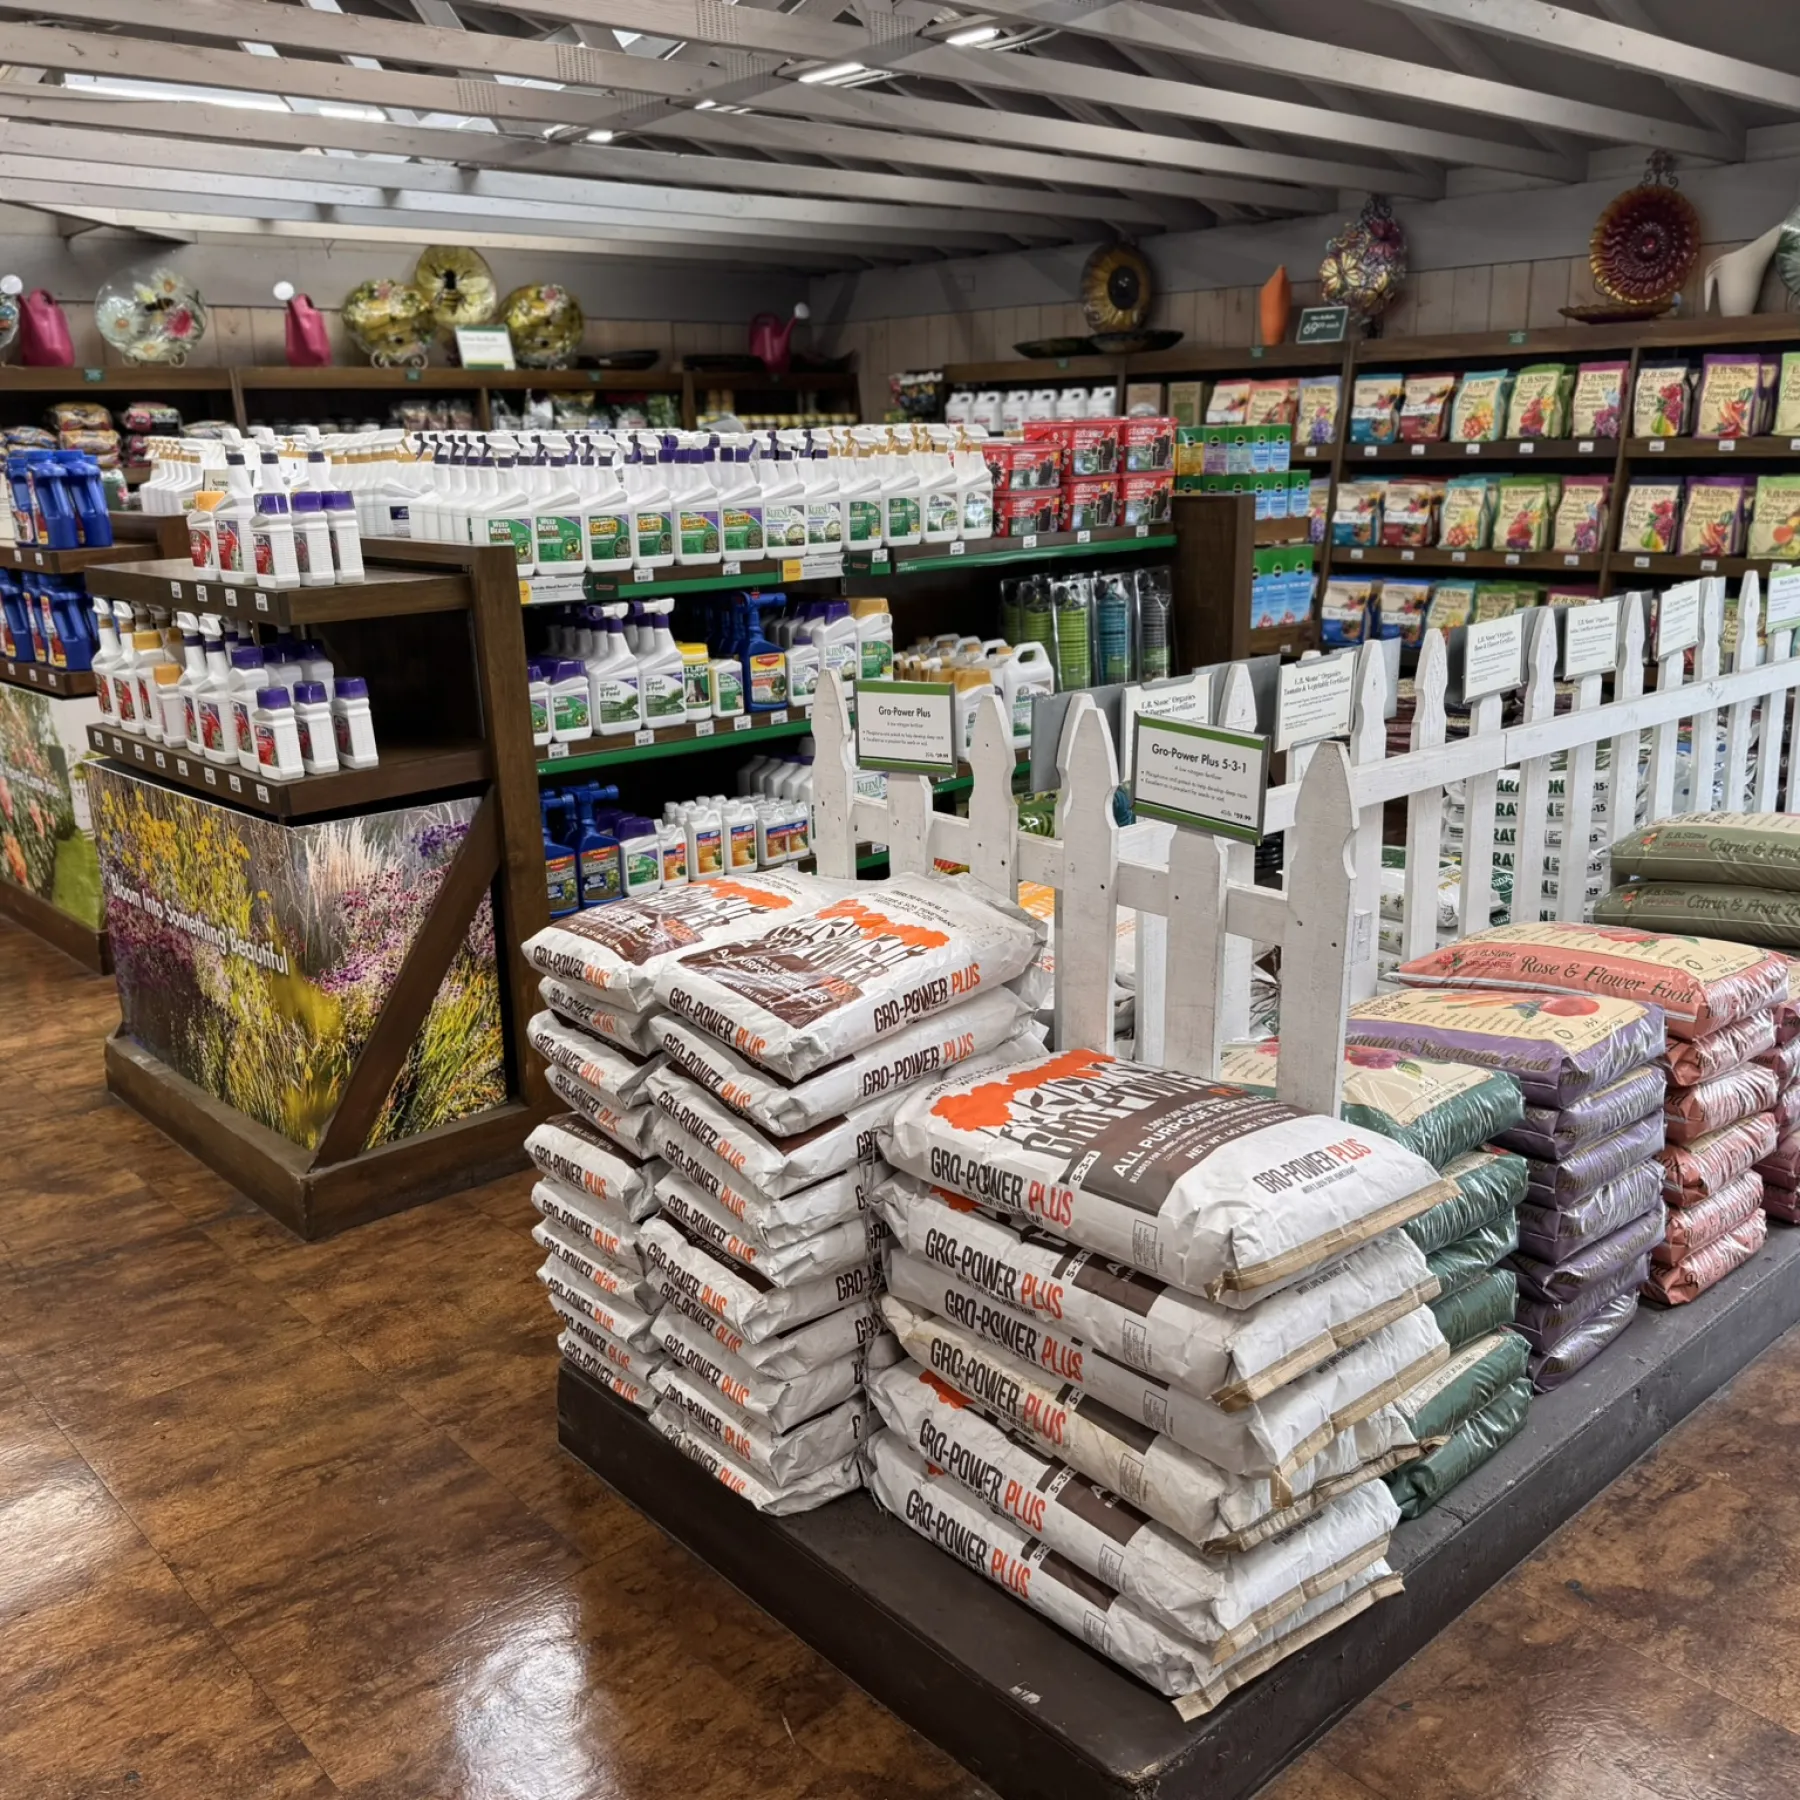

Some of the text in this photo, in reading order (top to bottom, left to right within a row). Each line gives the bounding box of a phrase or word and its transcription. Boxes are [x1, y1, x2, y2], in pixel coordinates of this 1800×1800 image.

[878, 705, 932, 718] Gro-Power Plus
[1152, 743, 1248, 774] Gro-Power Plus 5-3-1
[1708, 836, 1767, 857] Citrus &
[110, 872, 290, 976] Bloom Into Something Beautiful
[1686, 893, 1783, 917] Citrus & Fruit
[584, 964, 611, 991] PLUS
[873, 962, 981, 1033] GRO-POWER PLUS
[1520, 955, 1695, 1005] Rose & Flower Food
[669, 987, 767, 1061] GRO-POWER PLUS
[580, 1061, 606, 1090] PLUS
[662, 1032, 752, 1110] GRO-POWER PLUS
[862, 1045, 941, 1098] GRO-POWER
[942, 1031, 976, 1066] PLUS
[657, 1090, 748, 1174] GRO-POWER PLUS
[1112, 1149, 1147, 1179] ALL
[1138, 1108, 1214, 1150] PURPOSE
[535, 1144, 607, 1200] GRO-POWER PLUS
[664, 1140, 747, 1222] GRO-POWER PLUS
[930, 1146, 1026, 1209] GRO-POWER
[1028, 1180, 1074, 1229] PLUS
[1072, 1151, 1099, 1183] 5-3-1
[1252, 1138, 1372, 1194] GRO-POWER PLUS
[542, 1199, 619, 1255] GRO-POWER PLUS
[543, 1236, 592, 1279] GRO-POWER
[667, 1194, 758, 1264] GRO-POWER PLUS
[646, 1242, 728, 1318] GRO-POWER PLUS
[925, 1228, 1016, 1301] GRO-POWER
[1021, 1272, 1064, 1320] PLUS
[558, 1309, 631, 1372] GRO-POWER PLUS
[593, 1301, 615, 1331] PLUS
[715, 1323, 743, 1355] PLUS
[944, 1288, 1037, 1361] GRO-POWER
[1040, 1335, 1084, 1384] PLUS
[564, 1339, 639, 1403] GRO-POWER PLUS
[664, 1333, 750, 1406] GRO-POWER PLUS
[930, 1337, 1020, 1418] GRO-POWER
[1023, 1392, 1067, 1446] PLUS
[662, 1383, 751, 1461] GRO-POWER PLUS
[718, 1466, 747, 1495] PLUS
[919, 1418, 1046, 1533] GRO-POWER PLUS
[905, 1488, 1031, 1600] GRO-POWER PLUS
